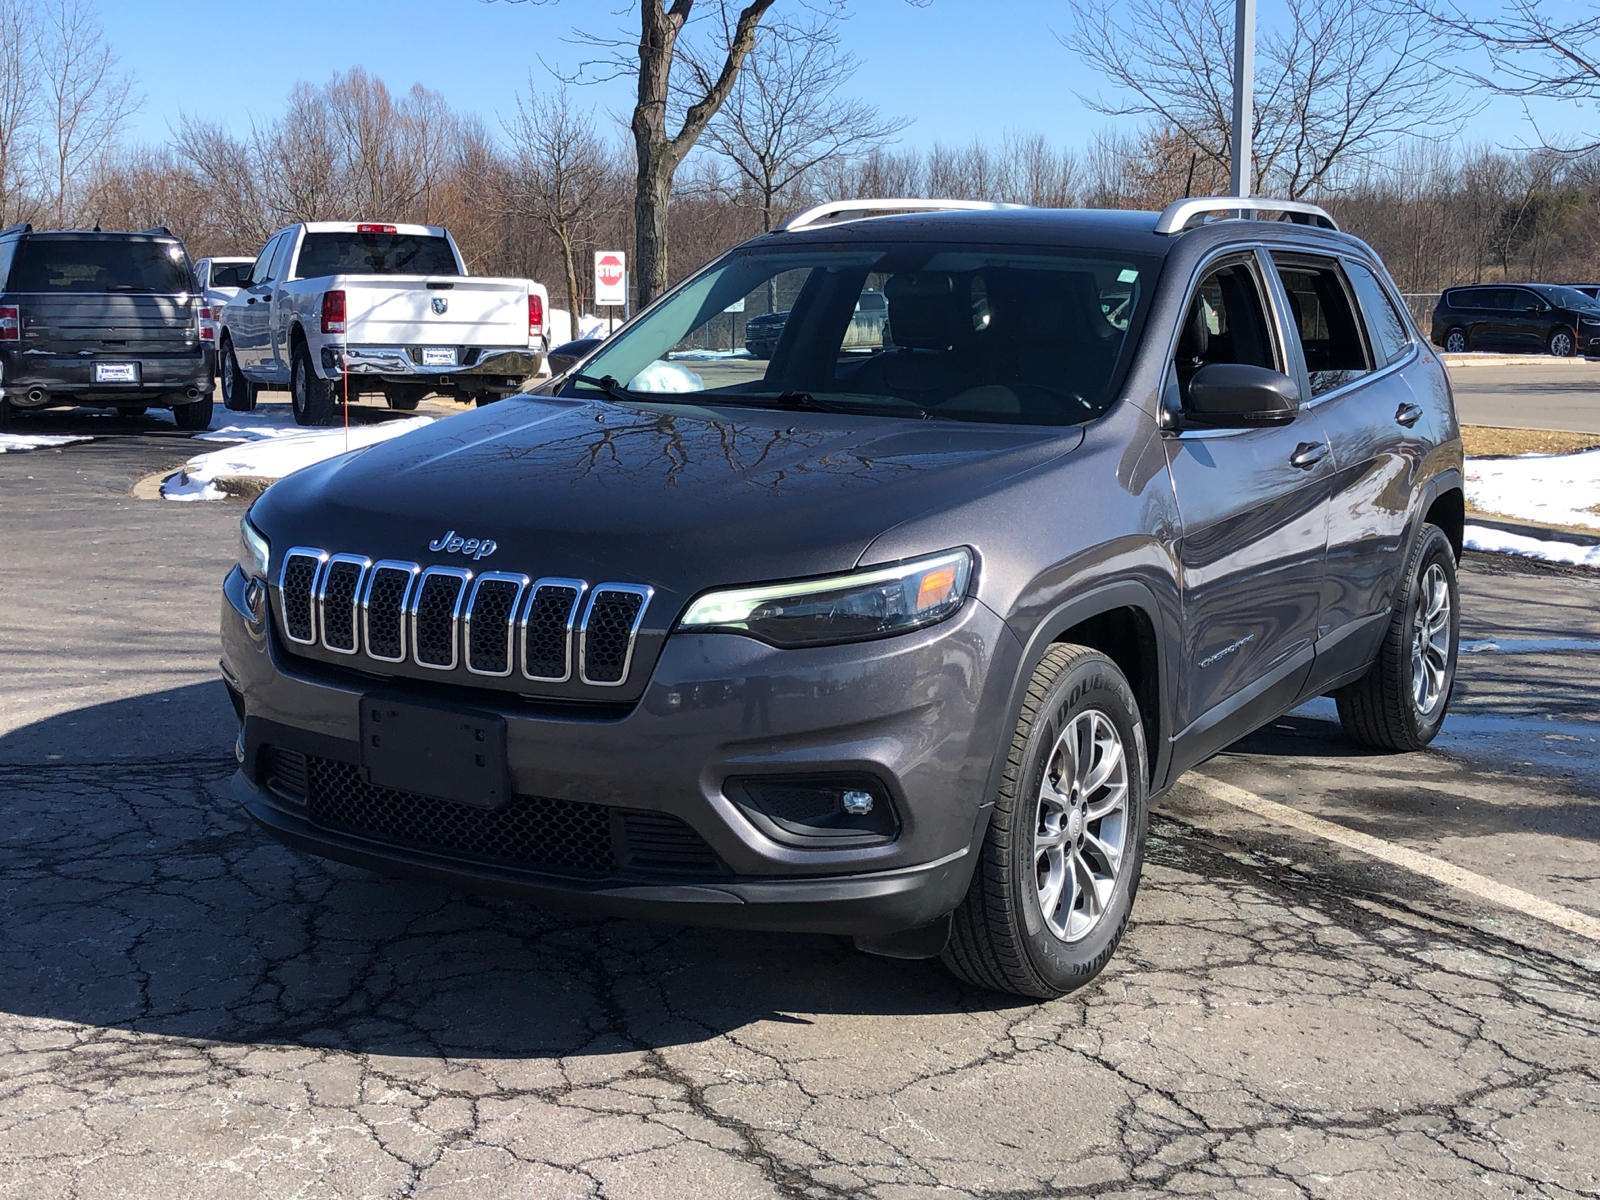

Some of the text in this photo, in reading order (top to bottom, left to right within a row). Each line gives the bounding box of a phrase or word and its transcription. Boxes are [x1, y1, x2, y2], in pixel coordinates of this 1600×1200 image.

[598, 264, 623, 278] STOP
[429, 530, 498, 561] Jeep
[1056, 673, 1133, 729] DOUGLAS
[1071, 912, 1127, 976] TOURING
